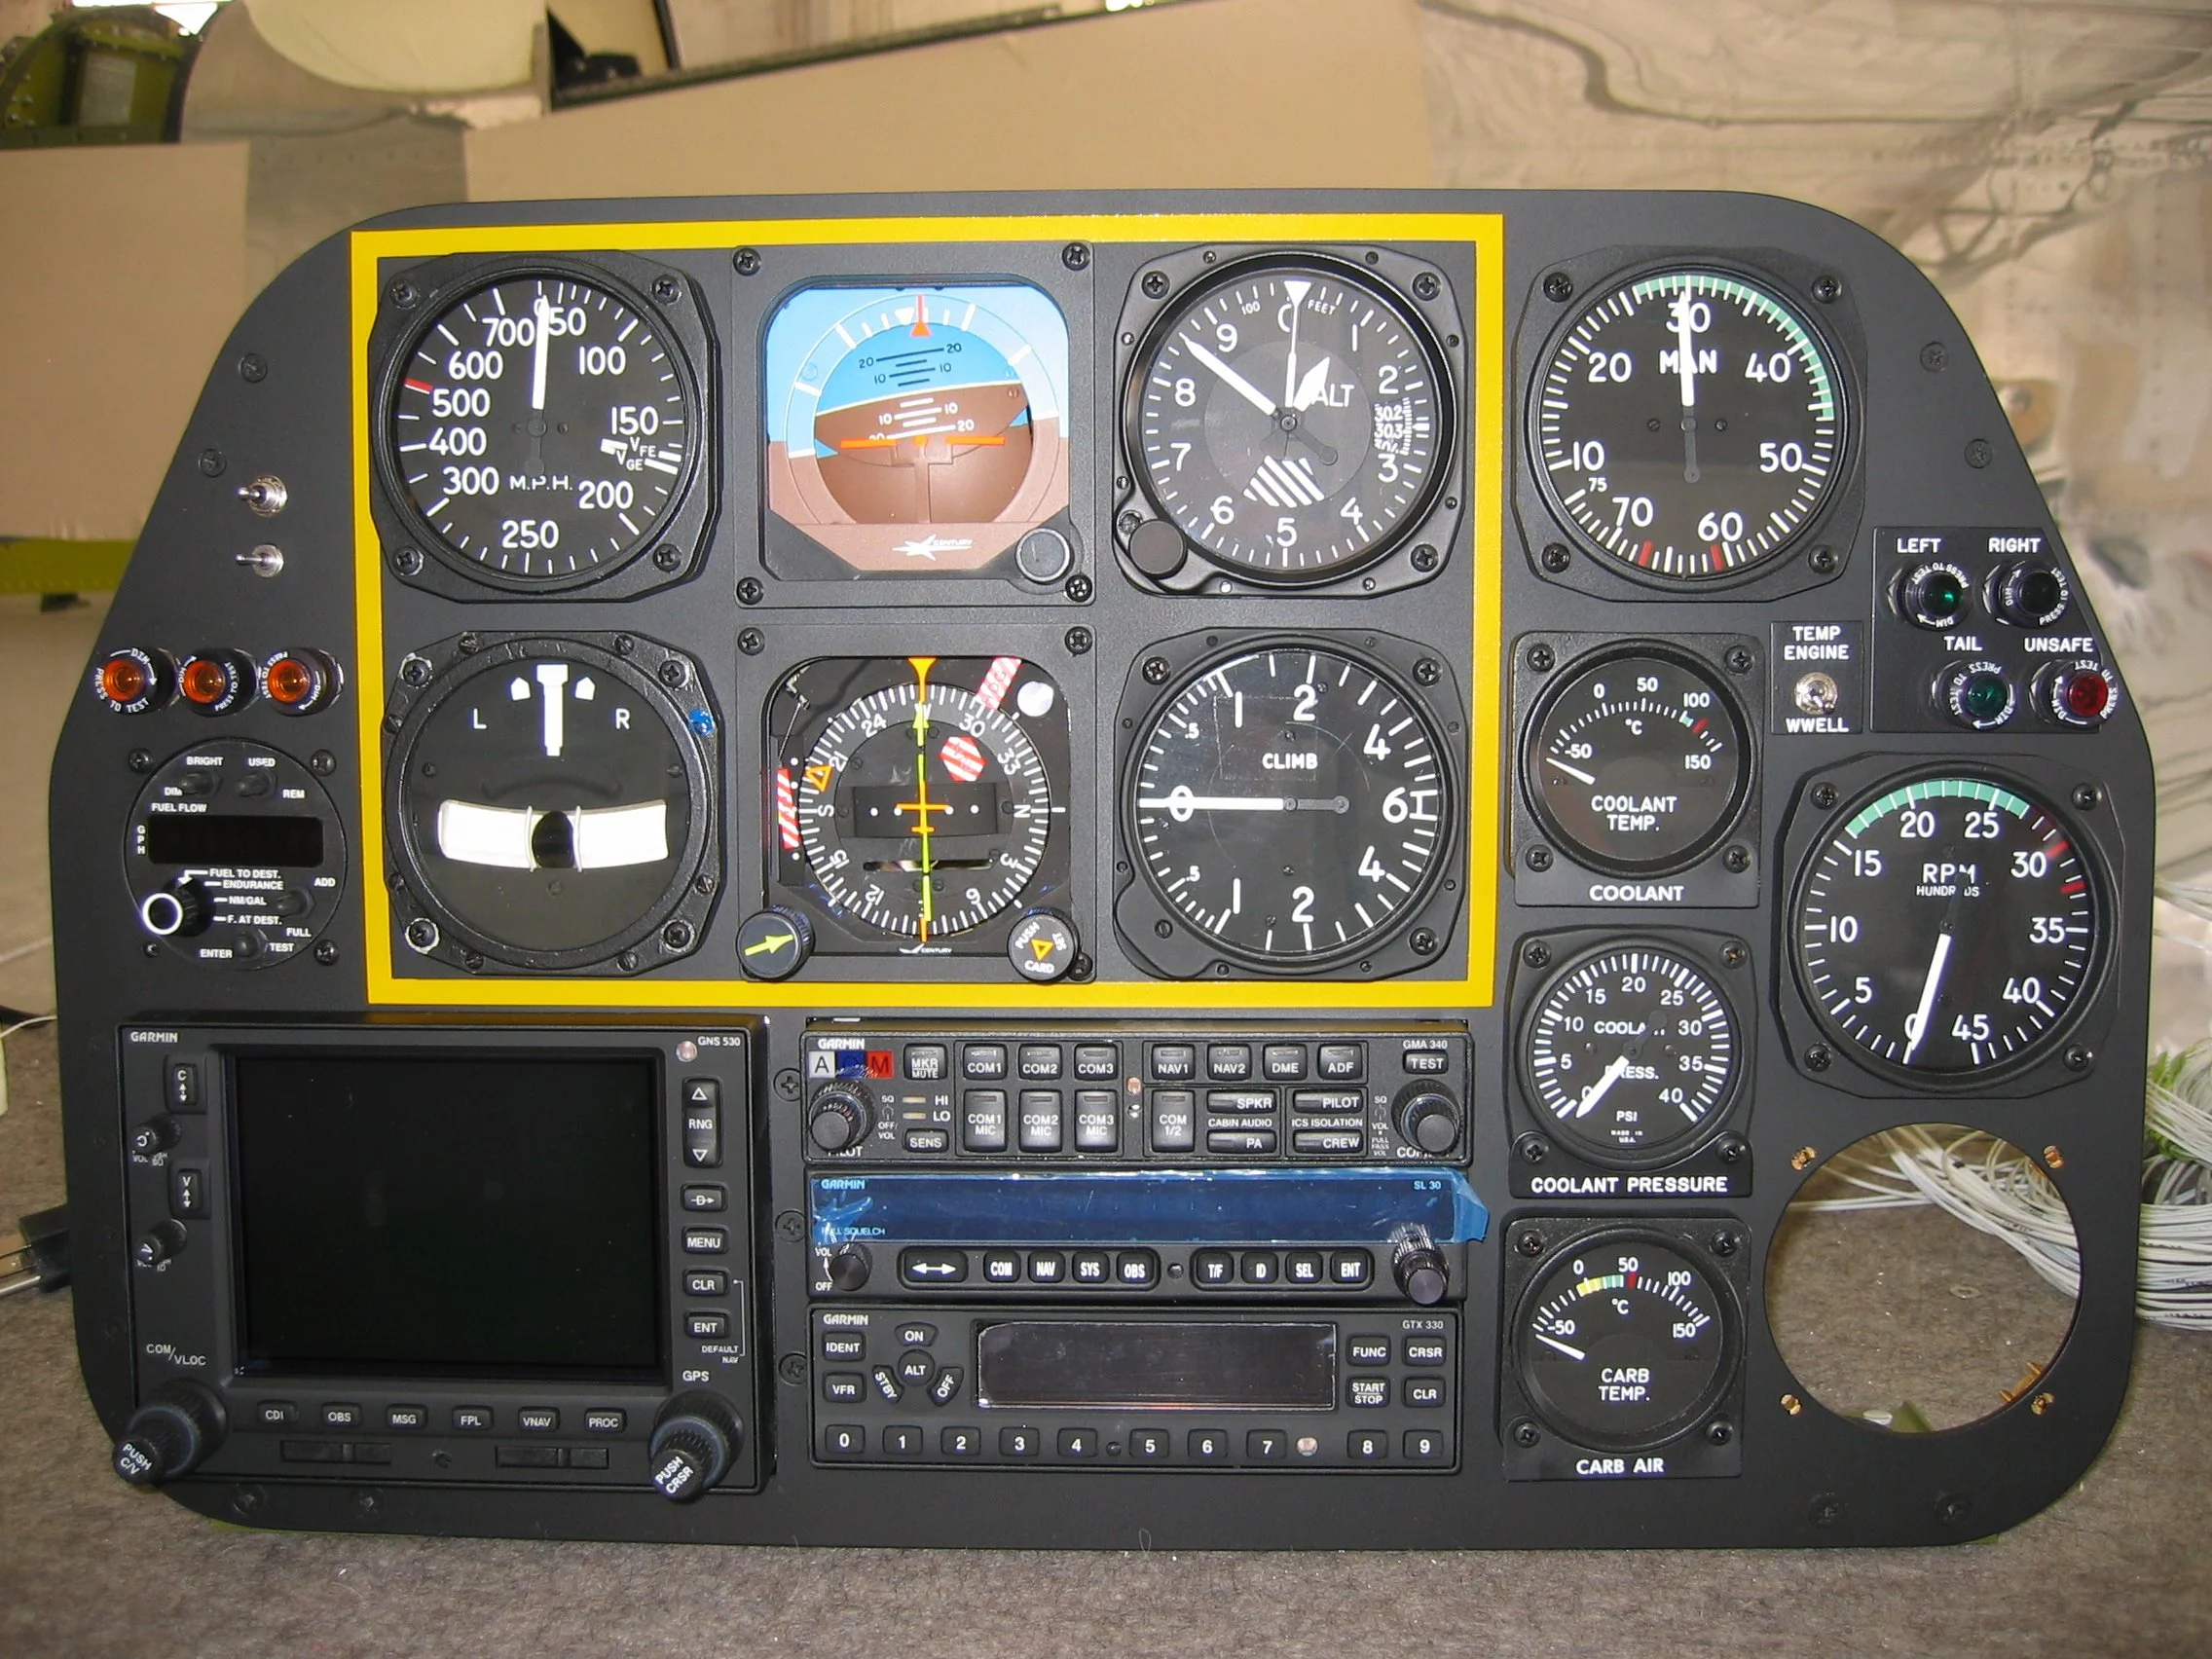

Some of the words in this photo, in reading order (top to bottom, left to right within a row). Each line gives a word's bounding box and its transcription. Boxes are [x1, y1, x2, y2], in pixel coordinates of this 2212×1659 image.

[1241, 302, 1260, 314] 100
[1308, 300, 1336, 315] FEET
[548, 308, 586, 336] 50
[483, 317, 535, 347] 700
[1216, 324, 1238, 352] 9
[946, 343, 962, 353] 20
[449, 350, 503, 380] 600
[579, 347, 626, 375] 100
[859, 356, 874, 369] 20
[940, 362, 951, 373] 10
[1589, 352, 1632, 383] 20
[1745, 353, 1790, 383] 40
[874, 374, 886, 385] 10
[1379, 366, 1399, 393] 2
[432, 388, 491, 418] 500
[1313, 385, 1354, 407] ALT
[944, 403, 958, 415] 10
[611, 407, 658, 435] 150
[958, 420, 974, 431] 20
[429, 427, 487, 456] 400
[1572, 441, 1605, 471] 10
[1759, 443, 1802, 471] 50
[443, 466, 499, 496] 300
[509, 476, 572, 491] M.P.H.
[578, 480, 634, 509] 200
[1612, 498, 1654, 527] 70
[1277, 518, 1297, 546] 5
[1698, 512, 1744, 541] 60
[502, 520, 559, 549] 250
[1897, 538, 1940, 553] LEFT
[1988, 538, 2041, 553] RIGHT
[1792, 626, 1841, 641] TEMP
[1944, 636, 1982, 650] TAIL
[2024, 638, 2093, 652] UNSAFE
[1784, 645, 1849, 660] ENGINE
[1637, 678, 1658, 692] 50
[1293, 684, 1316, 721] 2
[1683, 692, 1710, 707] 100
[473, 709, 486, 729] L
[616, 709, 630, 729] R
[1786, 718, 1849, 733] WWELL
[862, 716, 887, 738] 24
[959, 716, 986, 738] 30
[1625, 719, 1642, 735] °C
[1565, 744, 1592, 758] -50
[186, 756, 223, 766] BRIGHT
[248, 757, 276, 767] USED
[829, 750, 849, 771] 21
[997, 755, 1021, 775] 33
[1262, 753, 1318, 769] CLIMB
[1685, 755, 1712, 769] 150
[283, 790, 305, 799] REM
[152, 803, 177, 812] FUEL
[179, 803, 206, 813] FLOW
[1591, 795, 1677, 813] COOLANT
[1606, 814, 1660, 830] TEMP.
[1900, 811, 1936, 837] 20
[1965, 812, 2000, 838] 25
[1854, 850, 1881, 876] 15
[2010, 851, 2046, 877] 30
[210, 868, 235, 878] FUEL
[237, 869, 250, 878] TO
[253, 869, 281, 879] DEST.
[223, 880, 283, 890] ENDURANCE
[314, 878, 336, 887] ADD
[1589, 886, 1683, 902] COOLANT
[287, 928, 312, 938] FULL
[201, 948, 232, 958] ENTER
[270, 942, 294, 952] TEST
[1024, 960, 1054, 974] CARD
[1621, 977, 1646, 992] 20
[2003, 977, 2041, 1004] 40
[1660, 990, 1684, 1006] 25
[1677, 1019, 1702, 1036] 30
[1951, 1014, 1989, 1041] 45
[130, 1032, 178, 1043] GARMIN
[698, 1036, 720, 1046] GNS
[722, 1037, 741, 1046] 530
[818, 1038, 865, 1050] GARMIN
[1403, 1040, 1427, 1050] GMA
[1429, 1040, 1448, 1050] 340
[911, 1058, 939, 1068] MKR
[968, 1062, 1001, 1073] COM1
[1023, 1063, 1058, 1074] COM2
[1078, 1063, 1114, 1074] COM3
[1158, 1063, 1189, 1074] NAV1
[1213, 1063, 1246, 1074] NAV2
[1272, 1063, 1299, 1073] DME
[1328, 1062, 1354, 1073] ADF
[1411, 1058, 1444, 1069] TEST
[1678, 1055, 1703, 1071] 35
[1323, 1097, 1359, 1108] PILOT
[1658, 1088, 1683, 1103] 40
[1236, 1097, 1272, 1109] SPKR
[1208, 1118, 1240, 1127] CABIN
[1242, 1118, 1272, 1127] AUDIO
[1291, 1119, 1308, 1127] ICS
[1310, 1118, 1363, 1127] ISOLATION
[1616, 1111, 1637, 1122] PSI
[688, 1119, 713, 1129] RNG
[910, 1137, 941, 1148] SENS
[1246, 1138, 1263, 1149] PA
[1323, 1137, 1360, 1148] CREW
[821, 1179, 865, 1190] GARMIN
[1414, 1181, 1426, 1190] SL
[1429, 1180, 1442, 1190] 30
[1530, 1177, 1619, 1193] COOLANT
[1628, 1176, 1727, 1193] PRESSURE
[687, 1237, 720, 1248] MENU
[991, 1262, 1013, 1275] COM
[1036, 1262, 1055, 1276] NAV
[1080, 1262, 1099, 1276] SYS
[1296, 1264, 1313, 1277] SEL
[1342, 1263, 1361, 1277] ENT
[1618, 1257, 1639, 1272] 50
[692, 1280, 715, 1290] CLR
[1668, 1272, 1691, 1286] 100
[823, 1314, 868, 1325] GARMIN
[1403, 1320, 1423, 1330] GTX
[1425, 1320, 1444, 1330] 330
[694, 1322, 717, 1333] ENT
[1547, 1320, 1575, 1335] -50
[1673, 1323, 1696, 1338] 150
[904, 1331, 924, 1342] ON
[826, 1343, 860, 1352] IDENT
[1352, 1347, 1386, 1357] FUNC
[1409, 1347, 1442, 1357] CRSR
[682, 1371, 709, 1382] GPS
[904, 1365, 925, 1376] ALT
[1601, 1368, 1650, 1383] CARB
[832, 1384, 855, 1395] VFR
[875, 1372, 899, 1399] STBY
[938, 1375, 956, 1398] OFF
[1352, 1382, 1384, 1392] START
[1354, 1395, 1382, 1405] STOP
[1413, 1389, 1437, 1400] CLR
[1598, 1385, 1650, 1401] TEMP.
[265, 1410, 284, 1419] CDI
[328, 1413, 351, 1422] OBS
[392, 1414, 417, 1424] MSG
[461, 1415, 481, 1425] FPL
[523, 1417, 551, 1427] VNAV
[589, 1418, 618, 1428] PROC
[654, 1456, 683, 1485] PUSH
[1576, 1458, 1624, 1474] CARB
[1634, 1457, 1664, 1473] AIR
[665, 1467, 694, 1494] CRSR
